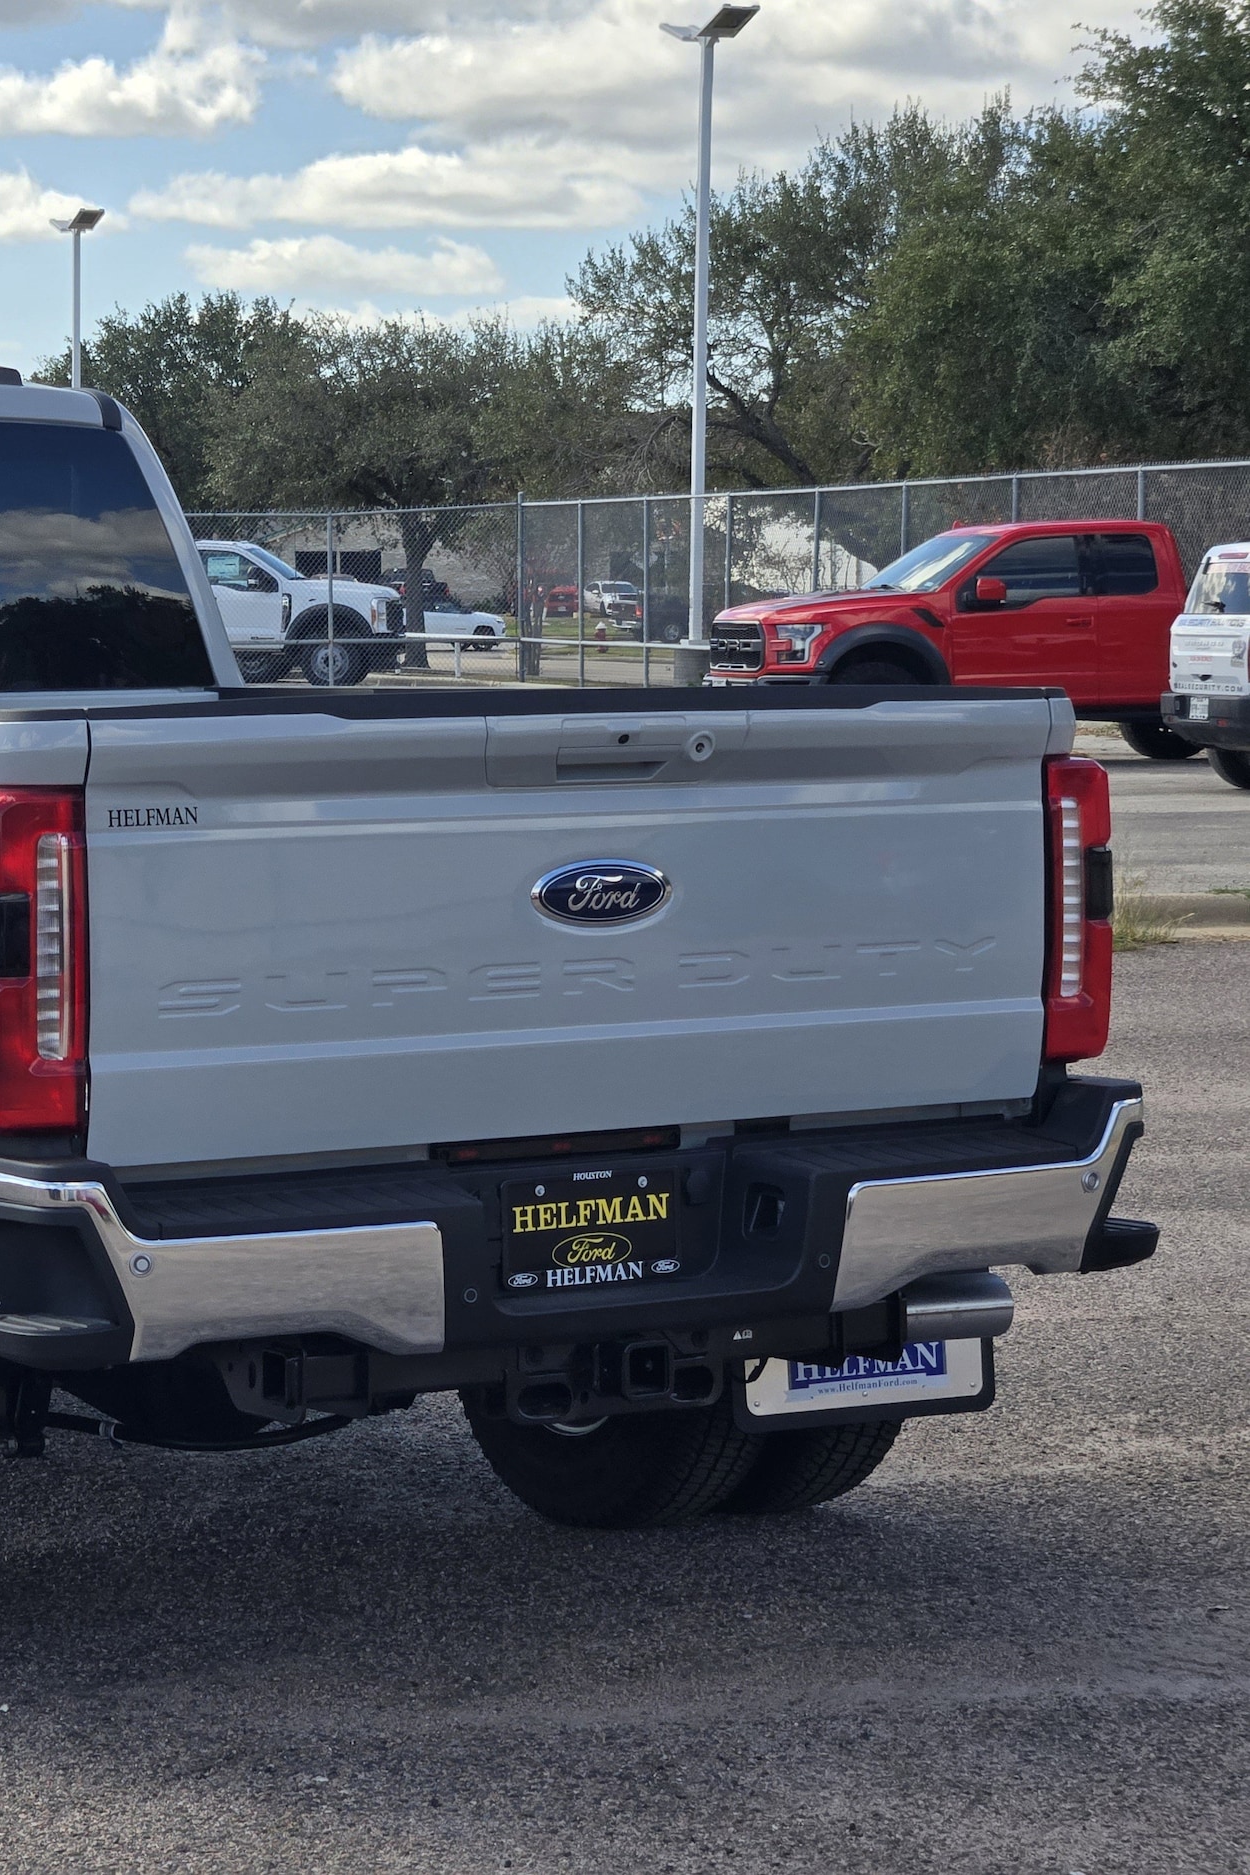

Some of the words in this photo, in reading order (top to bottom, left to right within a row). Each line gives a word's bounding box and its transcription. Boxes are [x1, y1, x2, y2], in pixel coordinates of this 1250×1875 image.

[107, 806, 199, 828] HELFMAN
[567, 874, 642, 912] Ford
[158, 957, 636, 1019] SUPER
[678, 936, 996, 989] DUTY
[572, 1170, 613, 1182] HOUSTON
[512, 1192, 670, 1233] HELFMAN
[566, 1237, 617, 1264] Ford
[546, 1260, 644, 1288] HELFMAN
[817, 1377, 918, 1395] www.HelfmanFord.com
